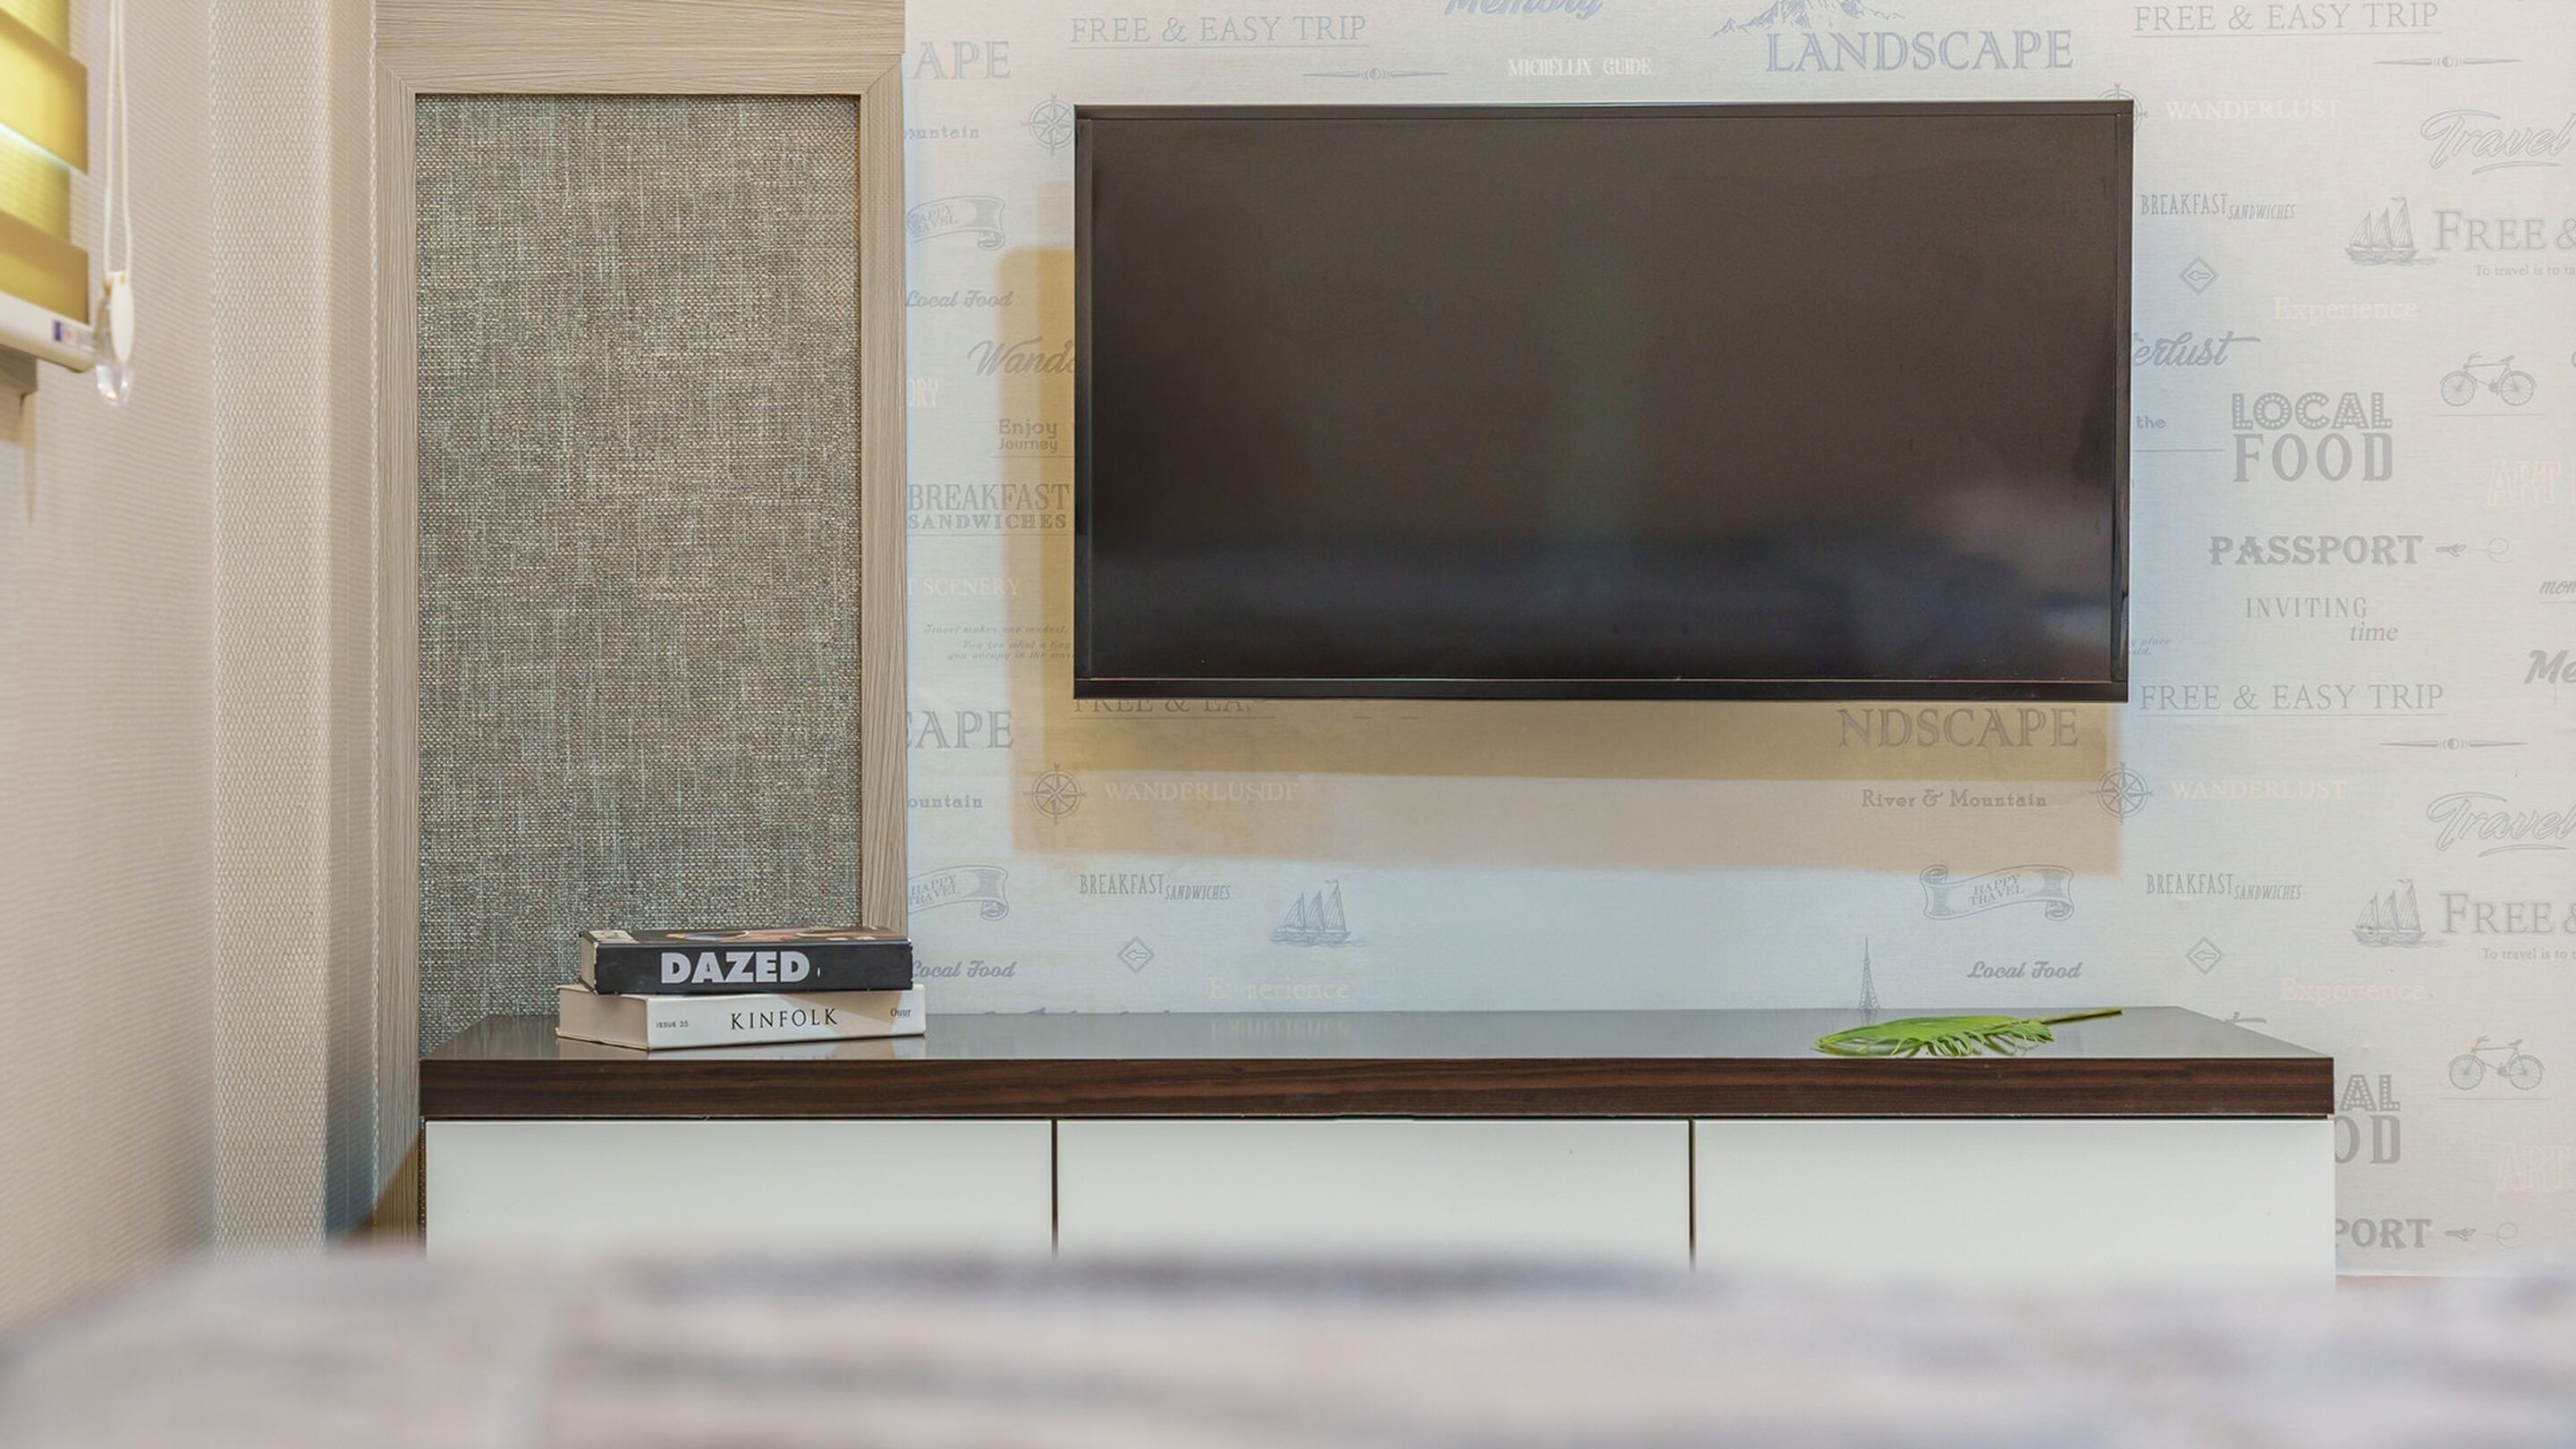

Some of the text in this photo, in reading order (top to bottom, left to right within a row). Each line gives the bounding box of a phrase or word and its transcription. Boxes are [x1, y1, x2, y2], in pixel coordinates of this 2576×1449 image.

[1072, 15, 1367, 43] FREE & EASY TRIP
[2133, 2, 2438, 31] FREE & EASY TRIP
[913, 40, 1011, 80] APE
[1766, 29, 2074, 72] LANDSCAPE
[1603, 56, 1654, 76] GUIDE
[2165, 99, 2343, 120] WANDERLUST
[2419, 109, 2576, 170] Travel
[2140, 193, 2296, 221] BREAKFAST SANDWICHES
[2433, 210, 2546, 250] FREE
[2473, 265, 2490, 276] To
[2495, 263, 2529, 276] travel
[905, 289, 1014, 308] Local Food
[2275, 297, 2419, 323] Experience
[2136, 415, 2166, 429] the
[2233, 392, 2394, 430] LOCAL
[999, 418, 1059, 439] Enjoy
[999, 438, 1058, 452] Journey
[2233, 433, 2394, 482] FOOD
[909, 483, 1071, 512] BREAKFAST
[908, 513, 1068, 530] SANDWICHES
[2210, 535, 2425, 566] PASSPORT
[922, 578, 1020, 596] SCENERY
[2245, 597, 2368, 619] INVITING
[2350, 622, 2400, 643] time
[2140, 683, 2445, 711] FREE & EASY TRIP
[908, 710, 1014, 750] APE
[1837, 708, 2079, 748] NDSCAPE
[1861, 789, 2046, 807] River & Mountain
[2171, 779, 2347, 801] WANDERLUST
[2426, 791, 2576, 852] Travel
[1079, 873, 1231, 902] BREAKFAST SANDWICHES
[1969, 884, 2025, 906] TRAVEL
[1973, 872, 2021, 895] HAPPY
[2147, 873, 2303, 902] BREAKFAST SANDWICHES
[2439, 892, 2555, 933] FREE
[2481, 946, 2498, 960] To
[2502, 947, 2537, 960] travel
[2555, 950, 2568, 960] to
[660, 952, 810, 984] DAZED
[912, 960, 1015, 979] Local Food
[1969, 960, 2082, 980] Local Food
[2279, 979, 2427, 1004] Experience
[731, 1008, 837, 1030] KINFOLK
[2339, 1073, 2402, 1112] AL
